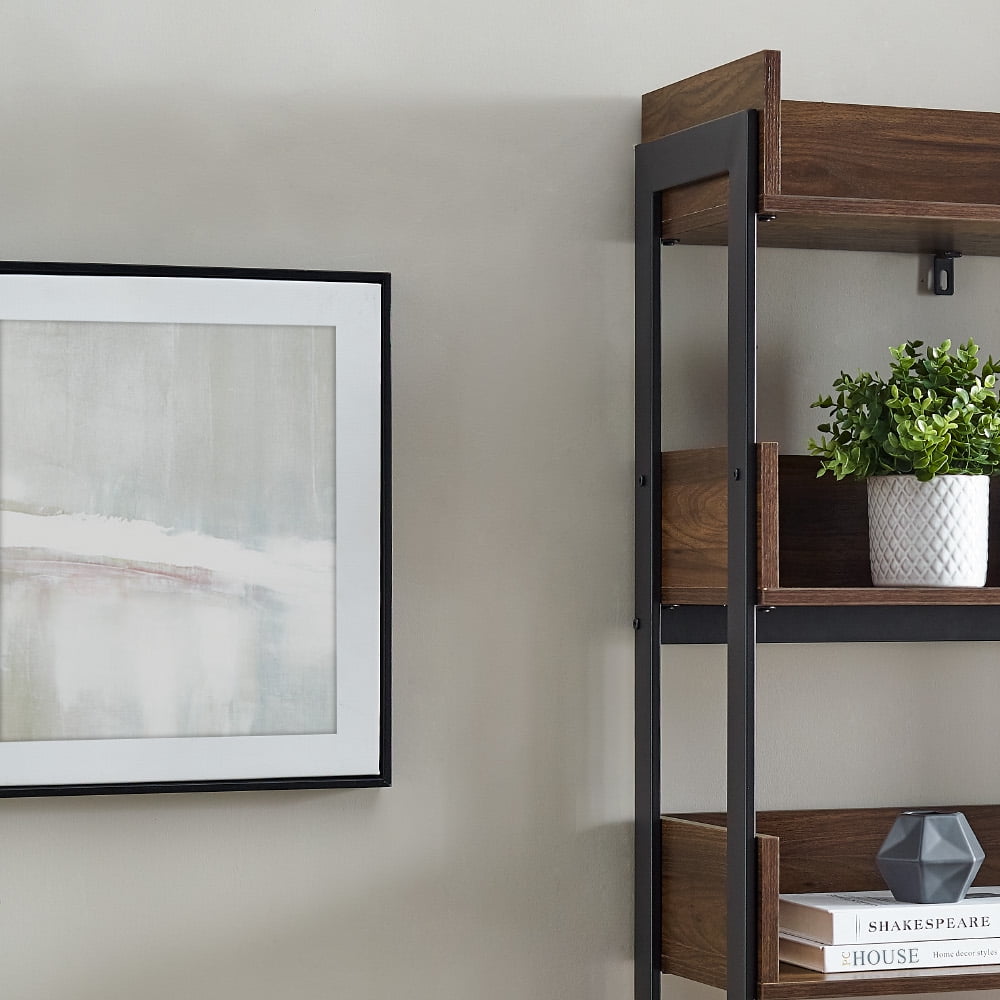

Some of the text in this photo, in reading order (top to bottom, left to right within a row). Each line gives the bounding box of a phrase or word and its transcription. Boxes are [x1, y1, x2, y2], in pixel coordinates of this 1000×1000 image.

[868, 916, 991, 933] SHAKESPEARE
[853, 948, 920, 966] HOUSE
[933, 950, 955, 959] Home
[955, 950, 976, 958] decor
[977, 948, 998, 957] styles
